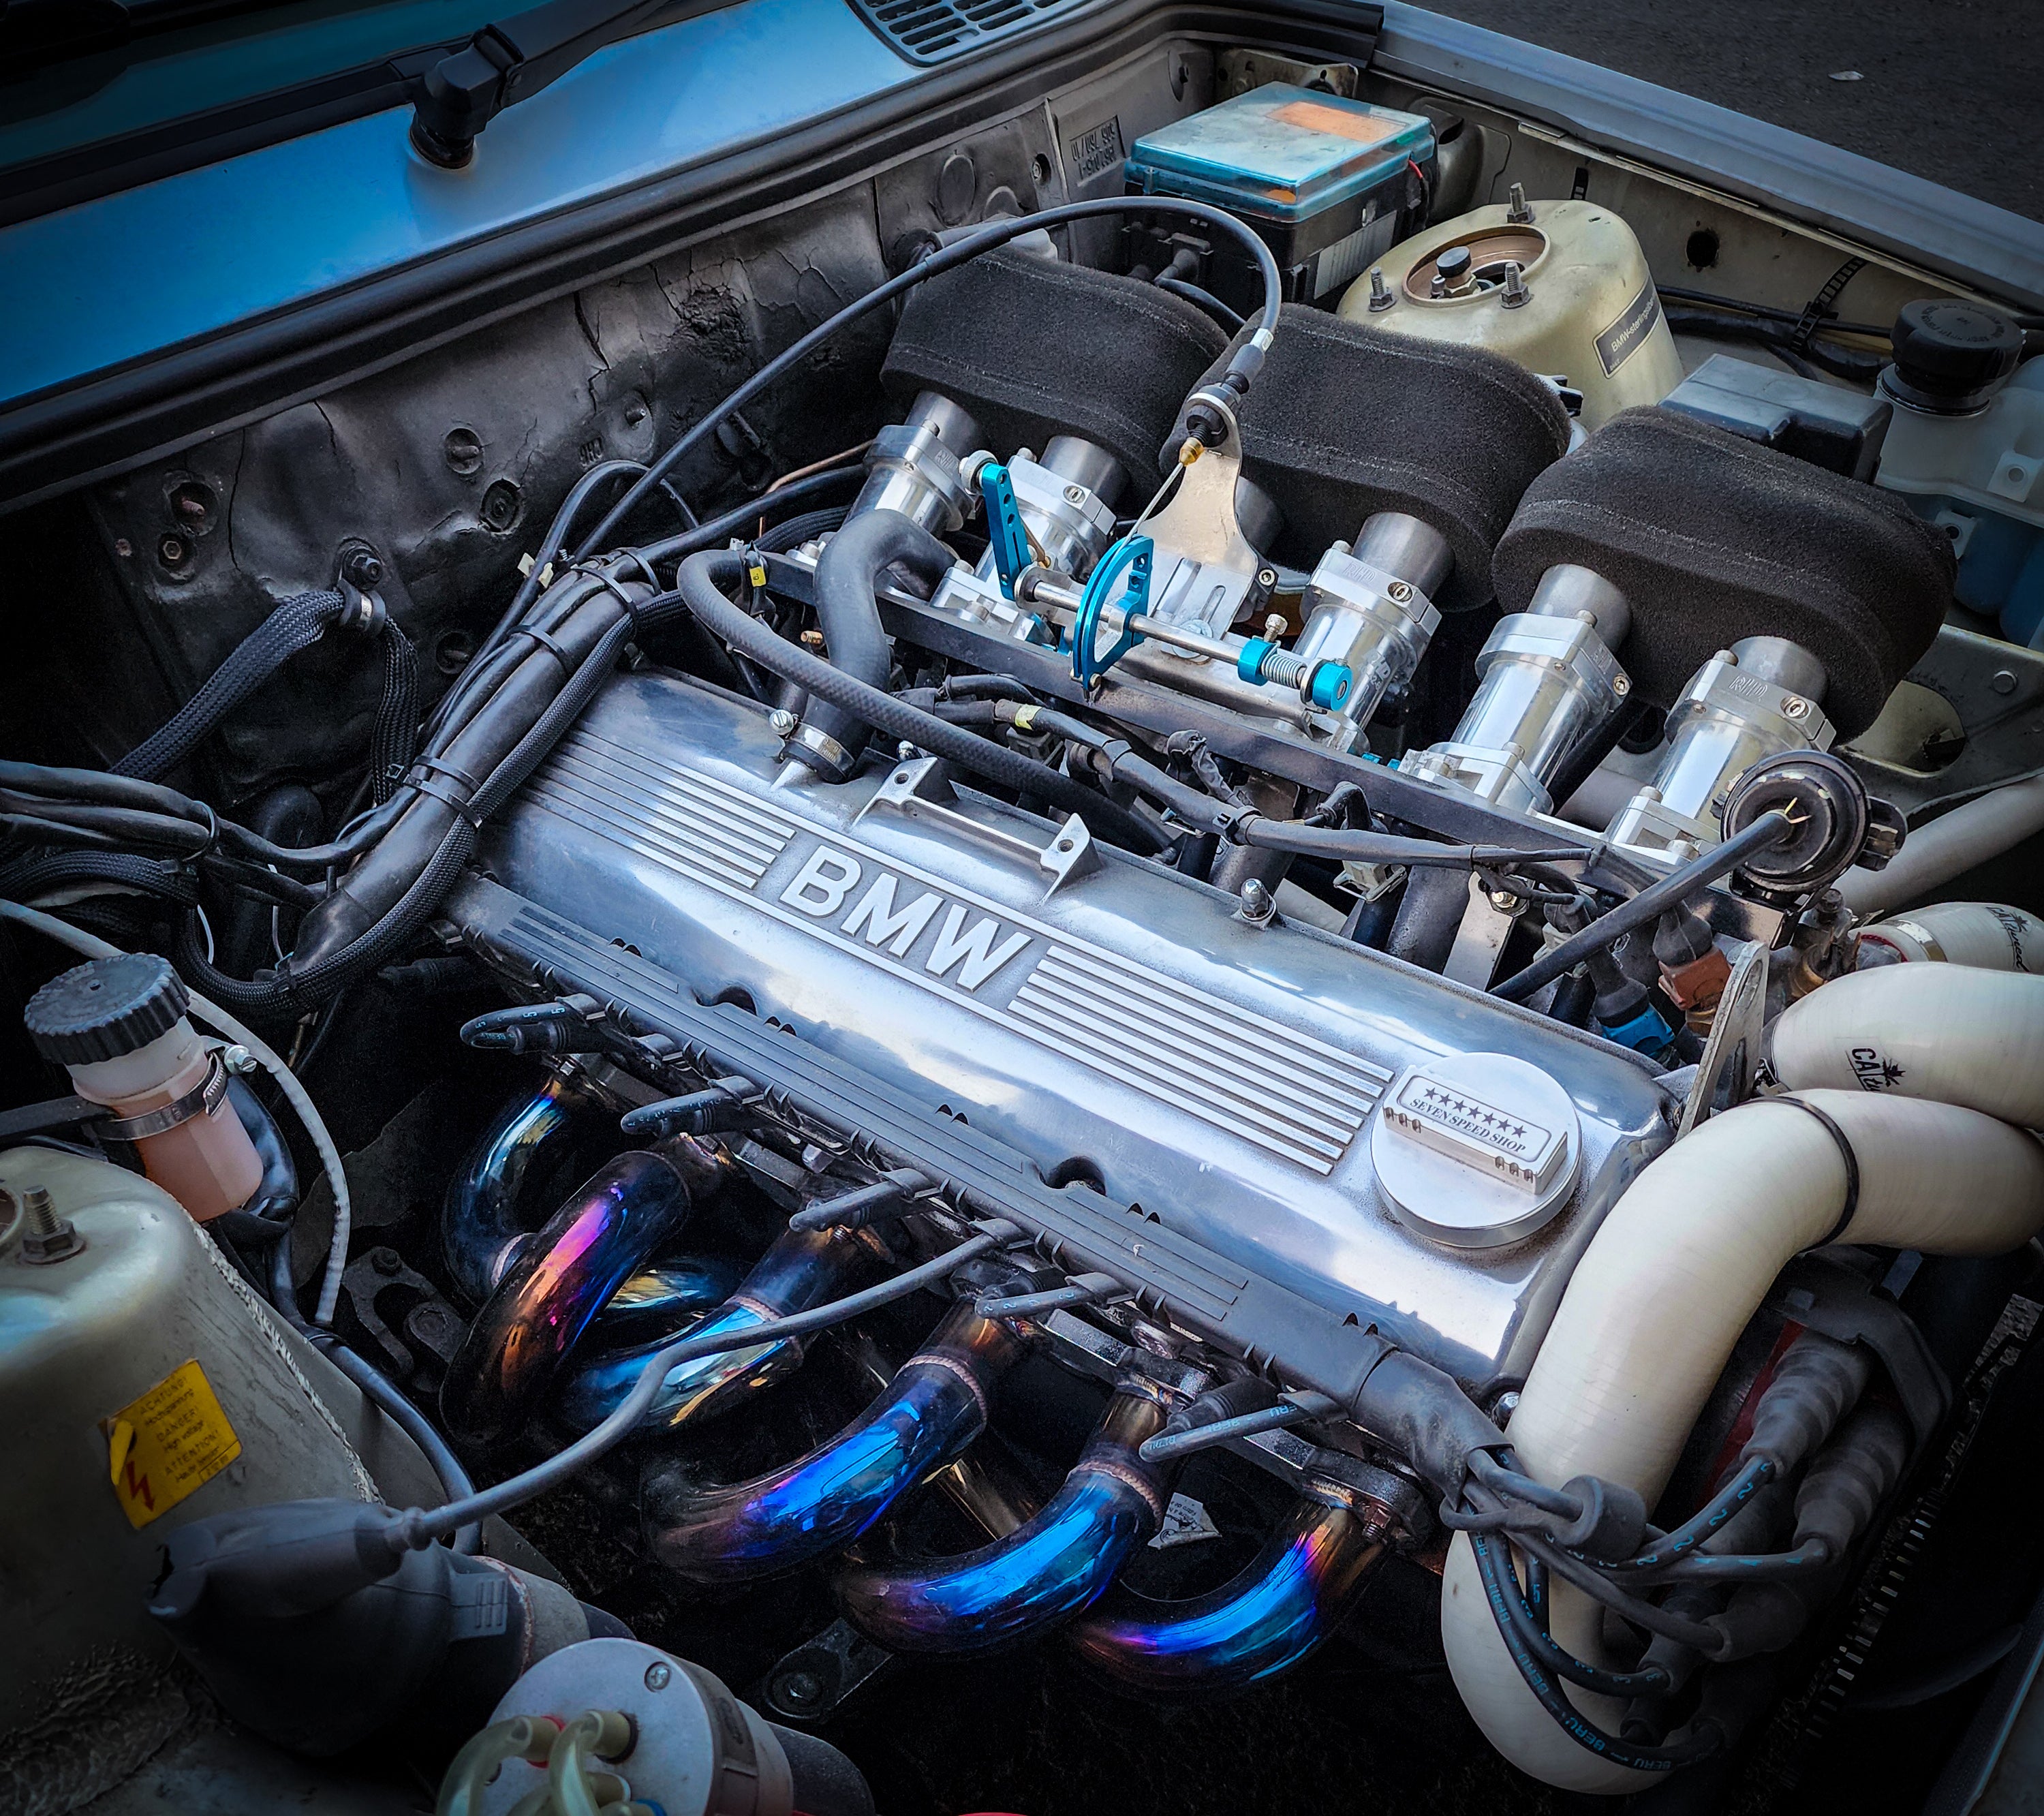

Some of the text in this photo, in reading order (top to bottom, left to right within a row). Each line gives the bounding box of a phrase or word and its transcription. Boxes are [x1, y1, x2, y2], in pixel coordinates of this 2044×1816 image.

[1343, 561, 1376, 582] RHD
[1729, 675, 1767, 698] RHD
[779, 844, 1034, 993] BMW
[1410, 1098, 1526, 1153] SEVEN SPEED SHOP
[140, 1377, 187, 1415] ACHTUNG!
[157, 1406, 198, 1443] DANGER!
[165, 1430, 219, 1475] ATTENTION!
[1517, 1652, 1549, 1696] BERU
[1565, 1717, 1605, 1751] BERU
[1634, 1757, 1672, 1770] BERU
